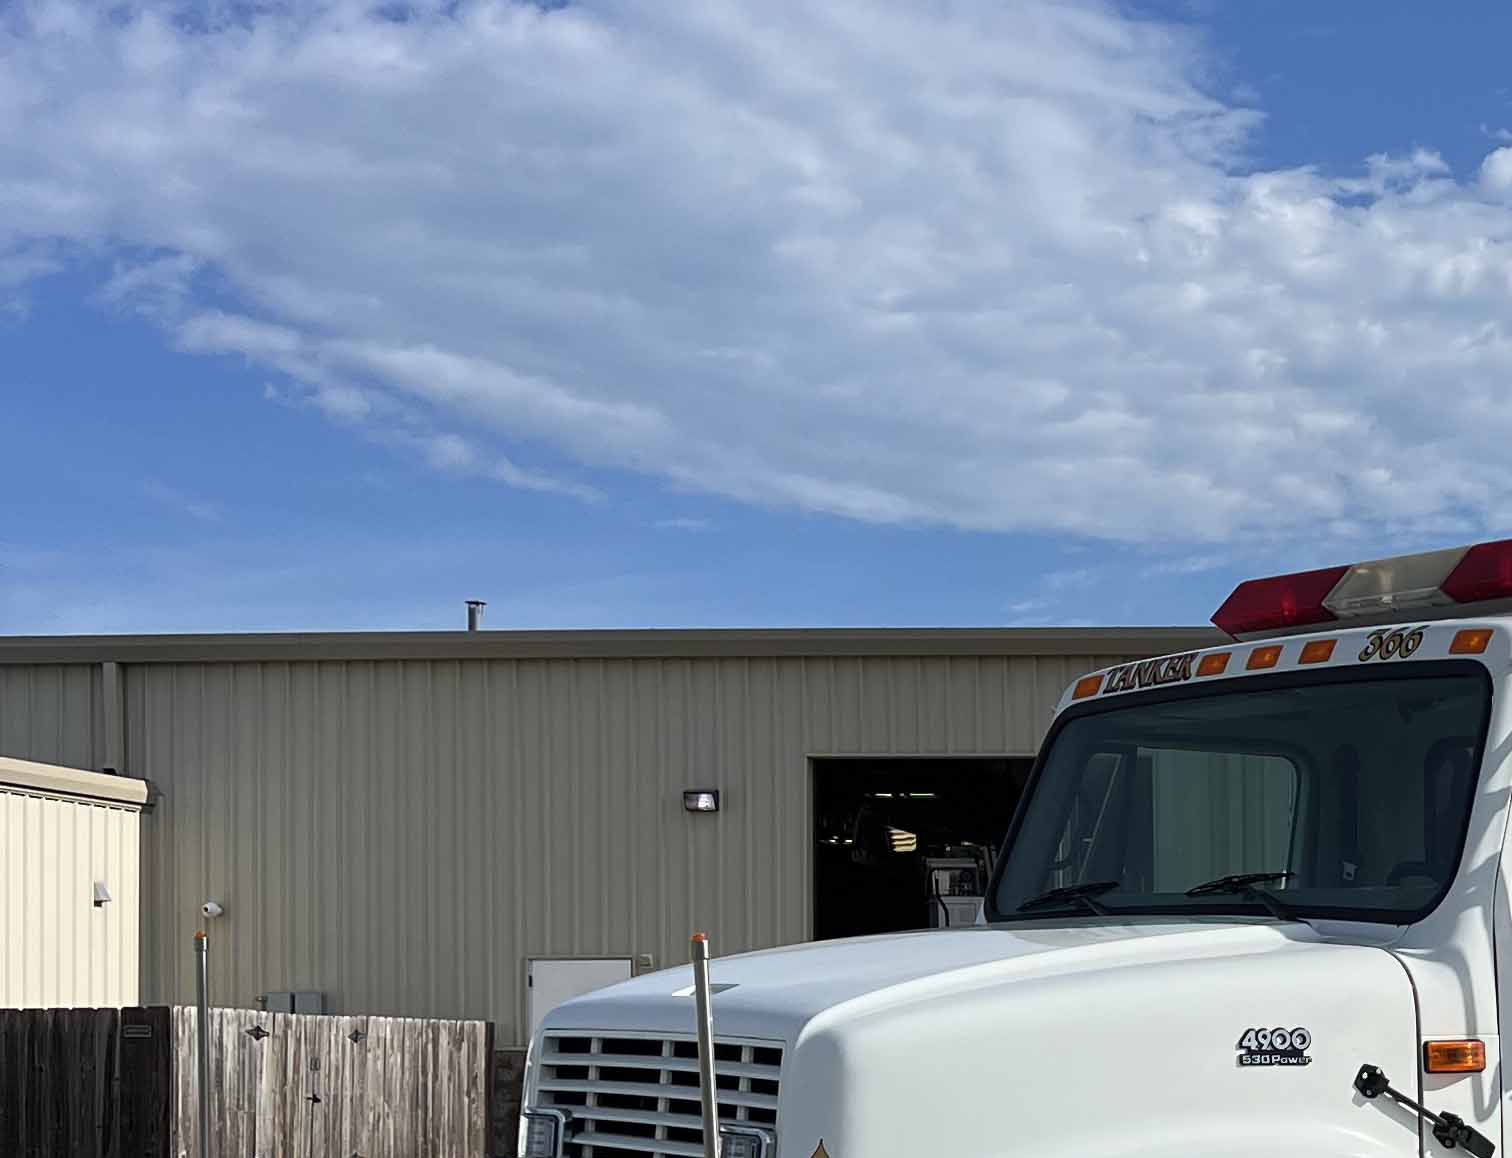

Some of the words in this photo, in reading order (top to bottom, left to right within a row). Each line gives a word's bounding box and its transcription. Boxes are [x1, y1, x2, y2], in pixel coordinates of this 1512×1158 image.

[1358, 625, 1430, 662] 366
[1102, 652, 1200, 694] TANKER
[1239, 1027, 1311, 1051] 4900
